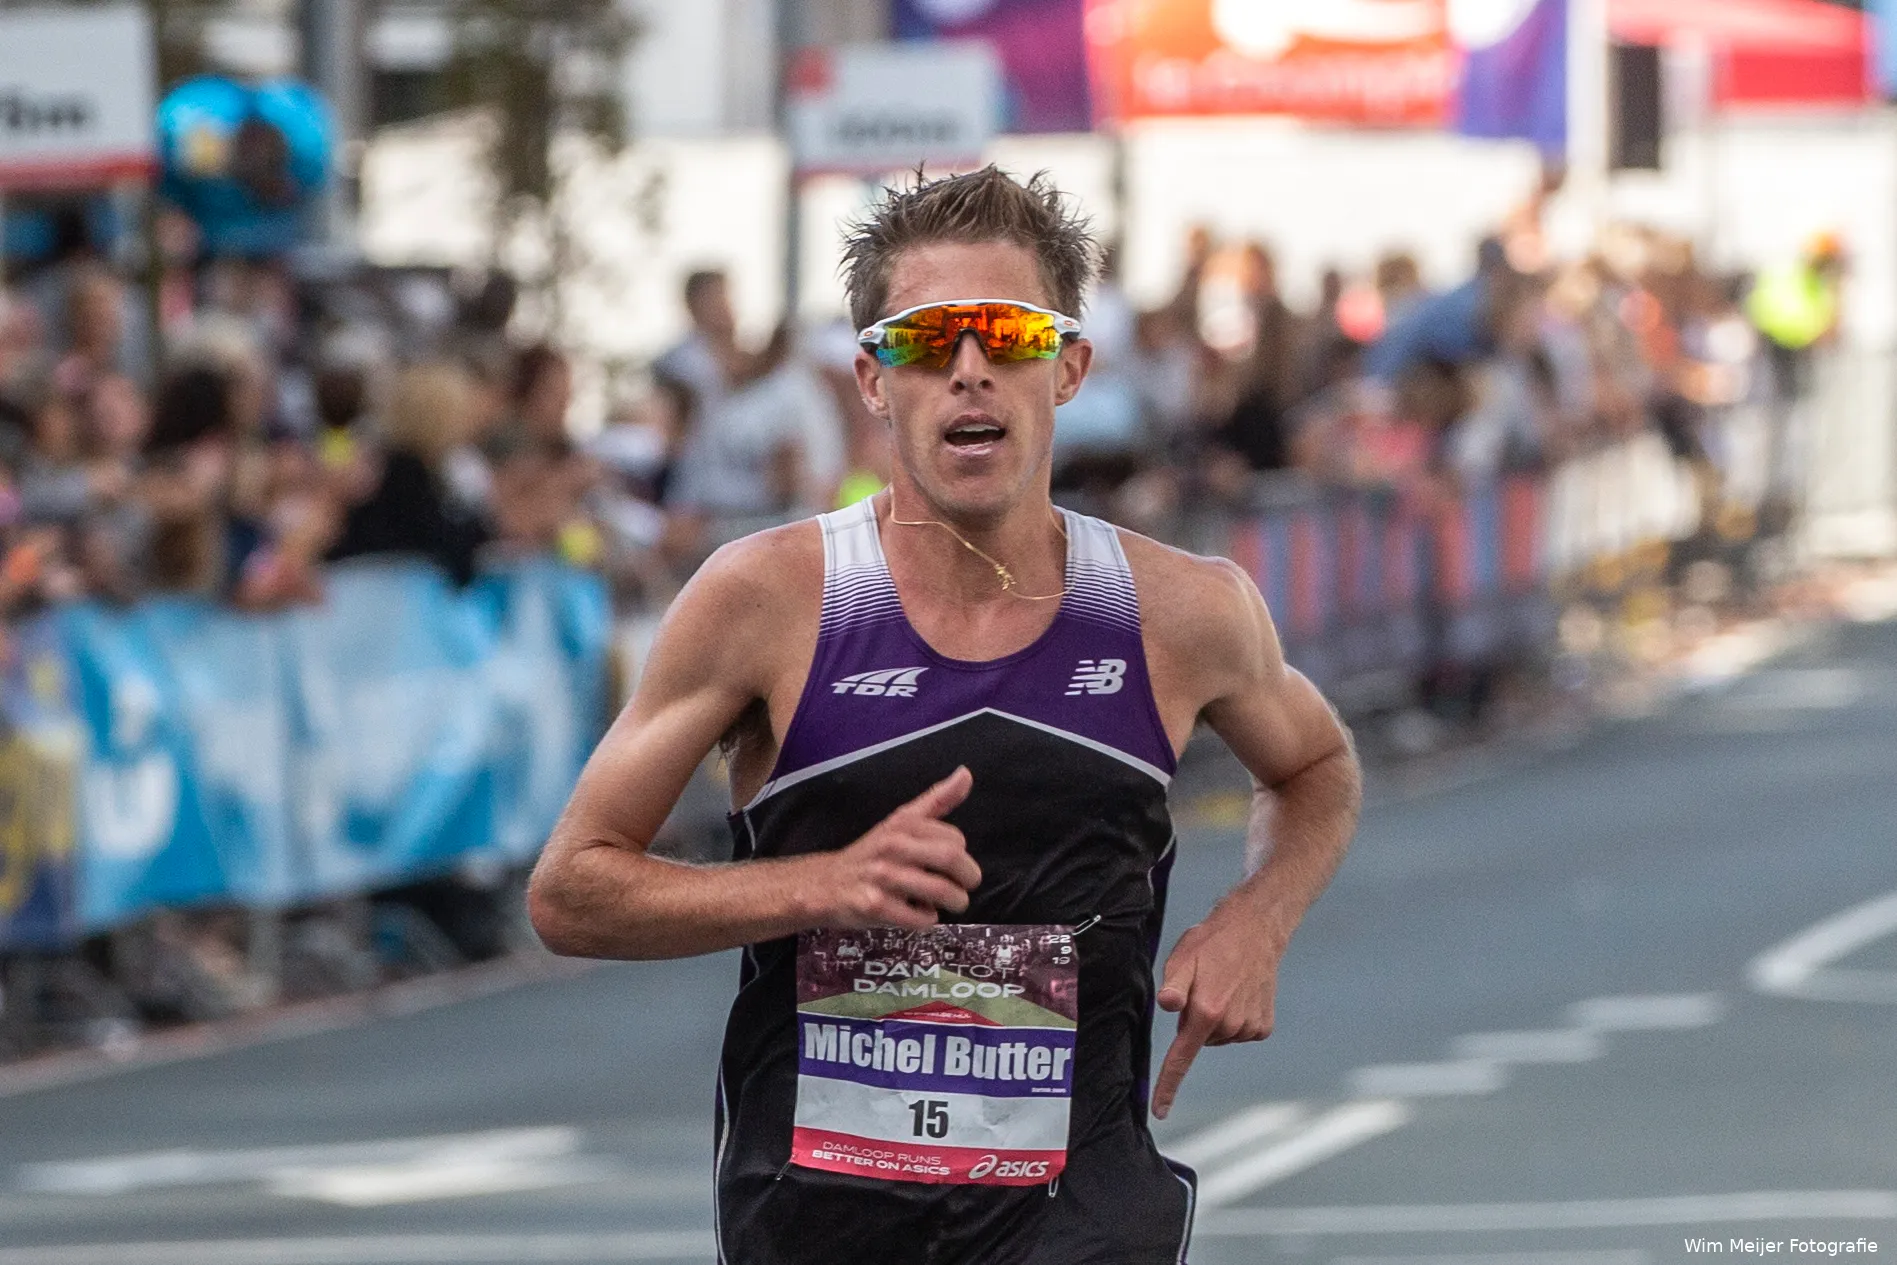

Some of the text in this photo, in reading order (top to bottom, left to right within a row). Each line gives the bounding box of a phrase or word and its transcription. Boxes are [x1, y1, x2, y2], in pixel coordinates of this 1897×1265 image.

[830, 682, 918, 697] TDR
[1048, 934, 1071, 944] 22
[1060, 945, 1072, 955] 9
[1052, 956, 1071, 965] 19
[863, 961, 1016, 979] DAM TOT
[853, 978, 1025, 998] DAMLOOP
[803, 1022, 1072, 1081] Michel Butter
[908, 1099, 949, 1139] 15
[822, 1141, 941, 1165] DAMLOOP RUNS
[812, 1150, 951, 1176] BETTER ON ASICS
[995, 1160, 1050, 1178] asics
